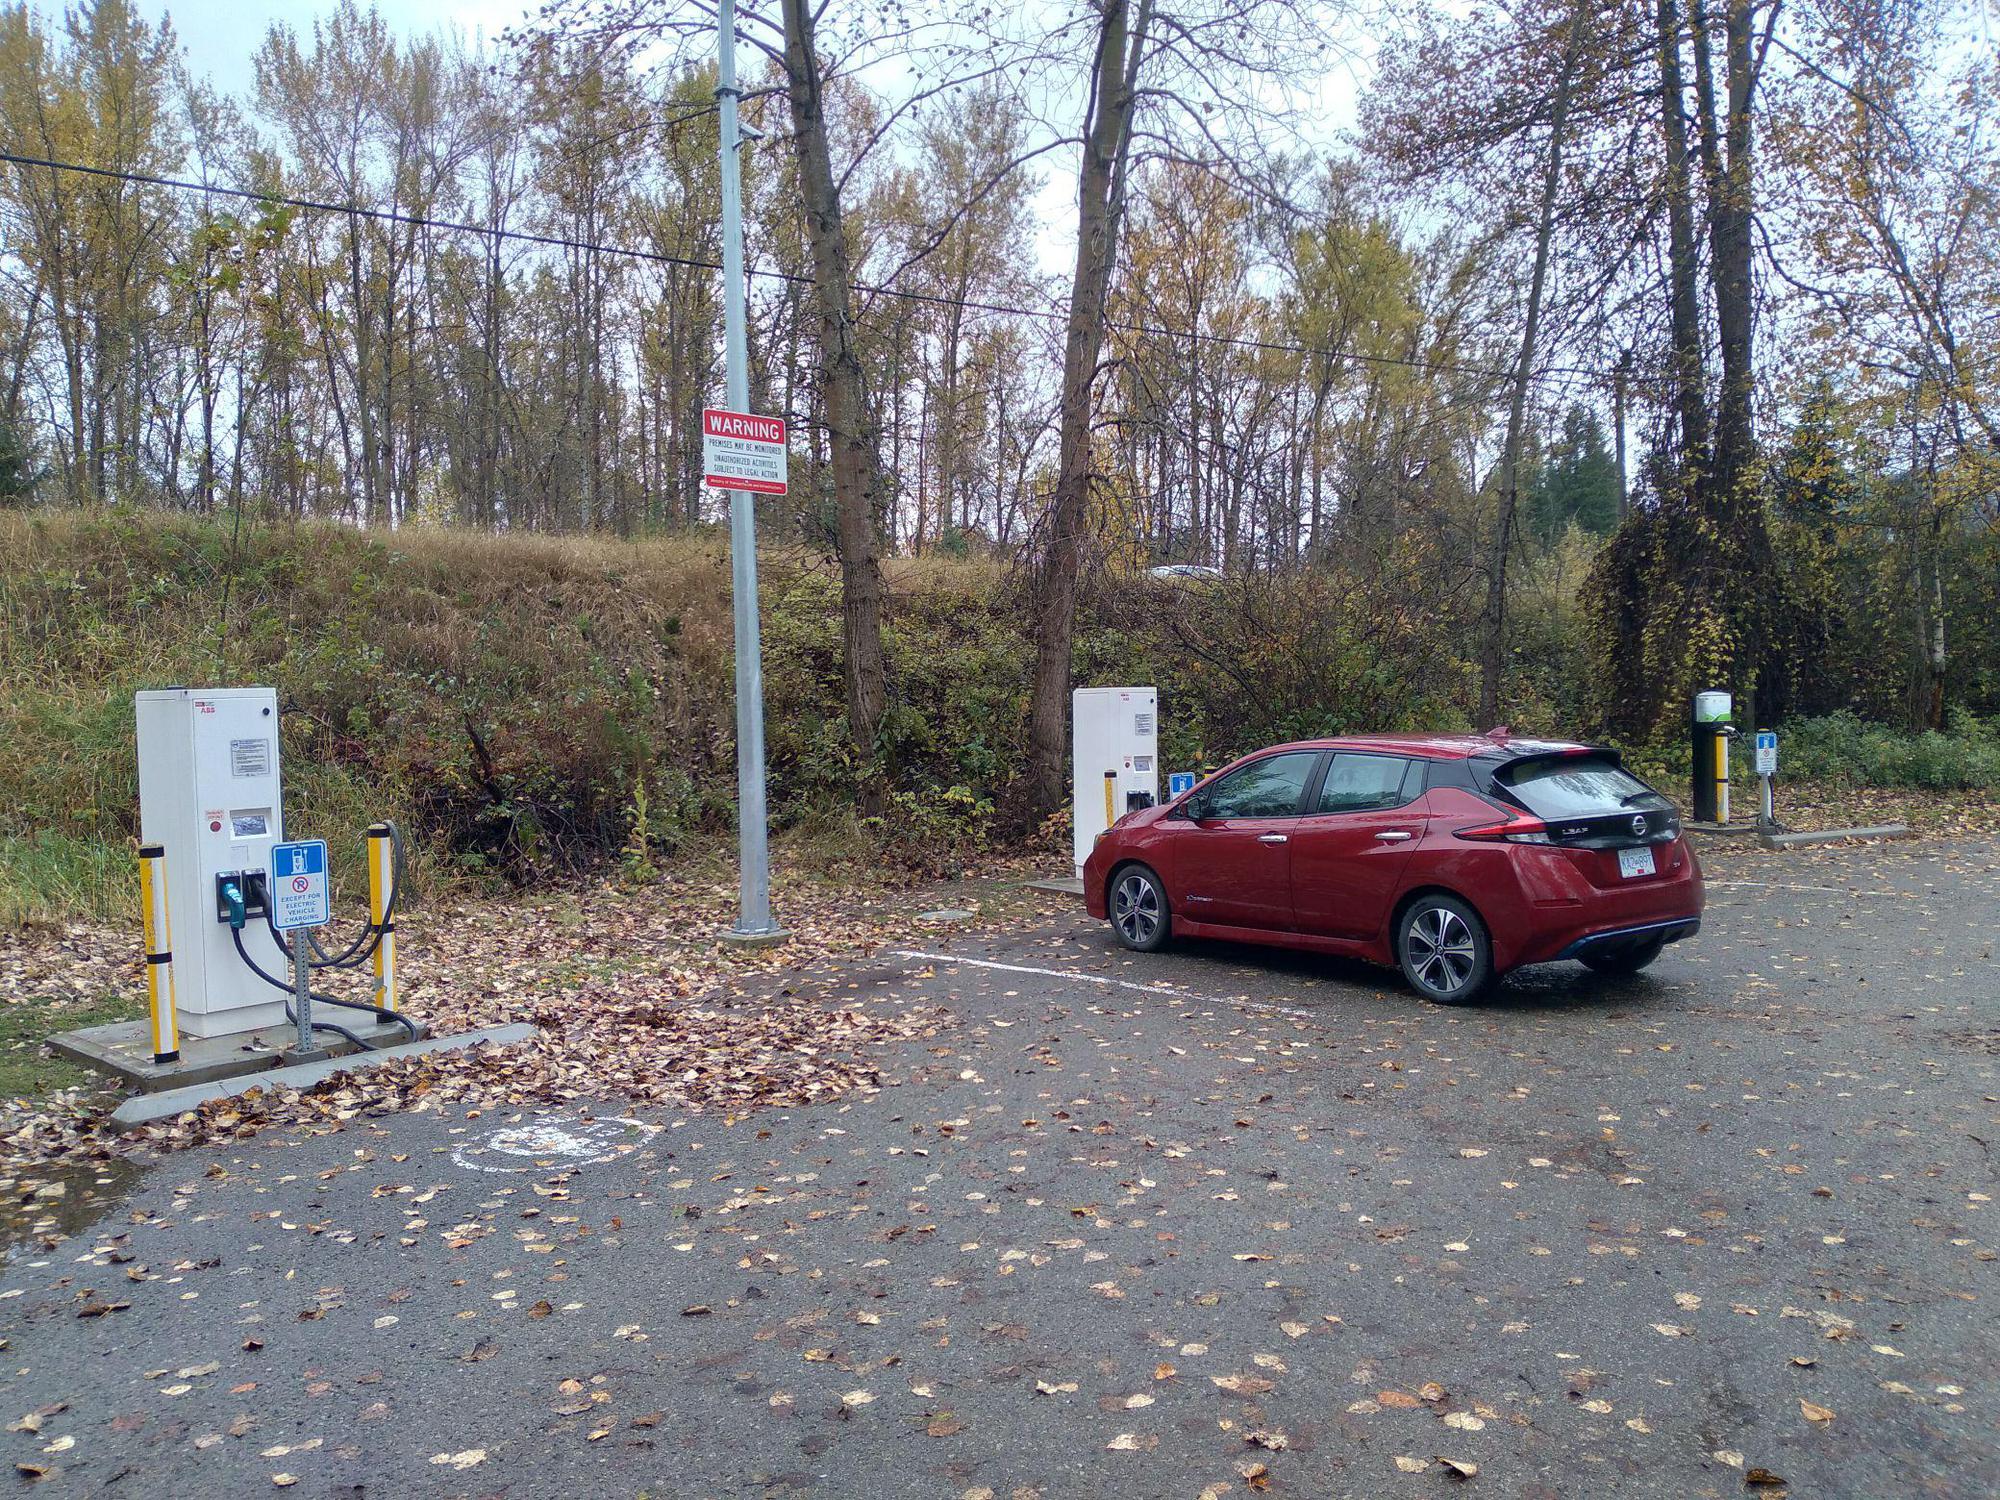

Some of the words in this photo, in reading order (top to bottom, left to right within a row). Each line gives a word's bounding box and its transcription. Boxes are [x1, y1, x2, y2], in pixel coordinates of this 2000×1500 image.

[709, 415, 779, 440] WARNING
[709, 438, 732, 449] PREMISES
[735, 442, 744, 450] MAY
[754, 444, 782, 455] MONITORED
[714, 454, 750, 465] UNAUTHORIZED
[752, 460, 778, 469] ACTIVITIES
[714, 464, 735, 473] SUBJECT
[736, 467, 743, 475] TO
[744, 467, 759, 477] LEGAL
[761, 469, 779, 479] ACTION
[1562, 827, 1589, 835] LEAF
[281, 894, 306, 903] EXCEPT
[307, 892, 321, 900] FOR
[286, 900, 317, 909] ELECTRIC
[287, 907, 315, 916] VEHICLE
[285, 914, 319, 923] CHARGING
